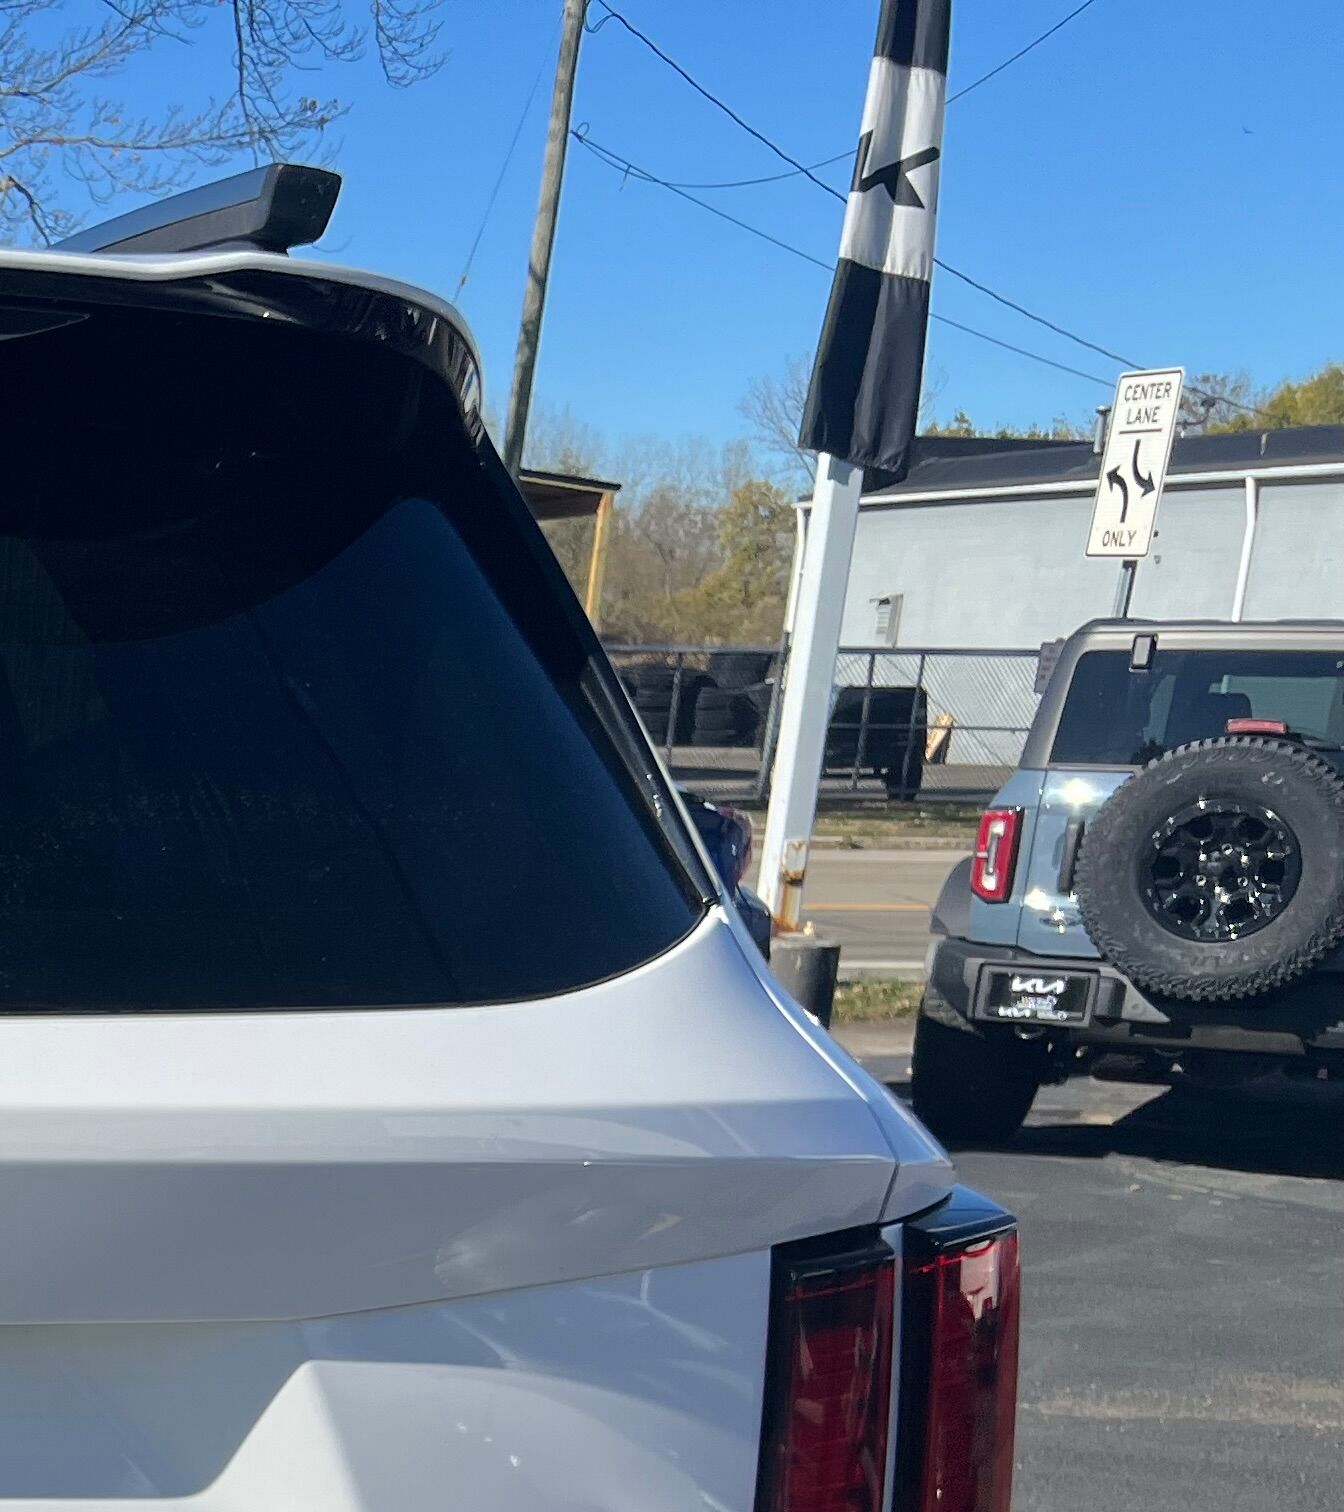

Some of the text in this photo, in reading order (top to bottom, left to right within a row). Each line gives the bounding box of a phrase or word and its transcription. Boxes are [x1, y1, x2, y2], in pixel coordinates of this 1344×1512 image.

[1124, 381, 1172, 402] CENTER
[1126, 406, 1161, 425] LANE
[1102, 530, 1136, 547] ONLY
